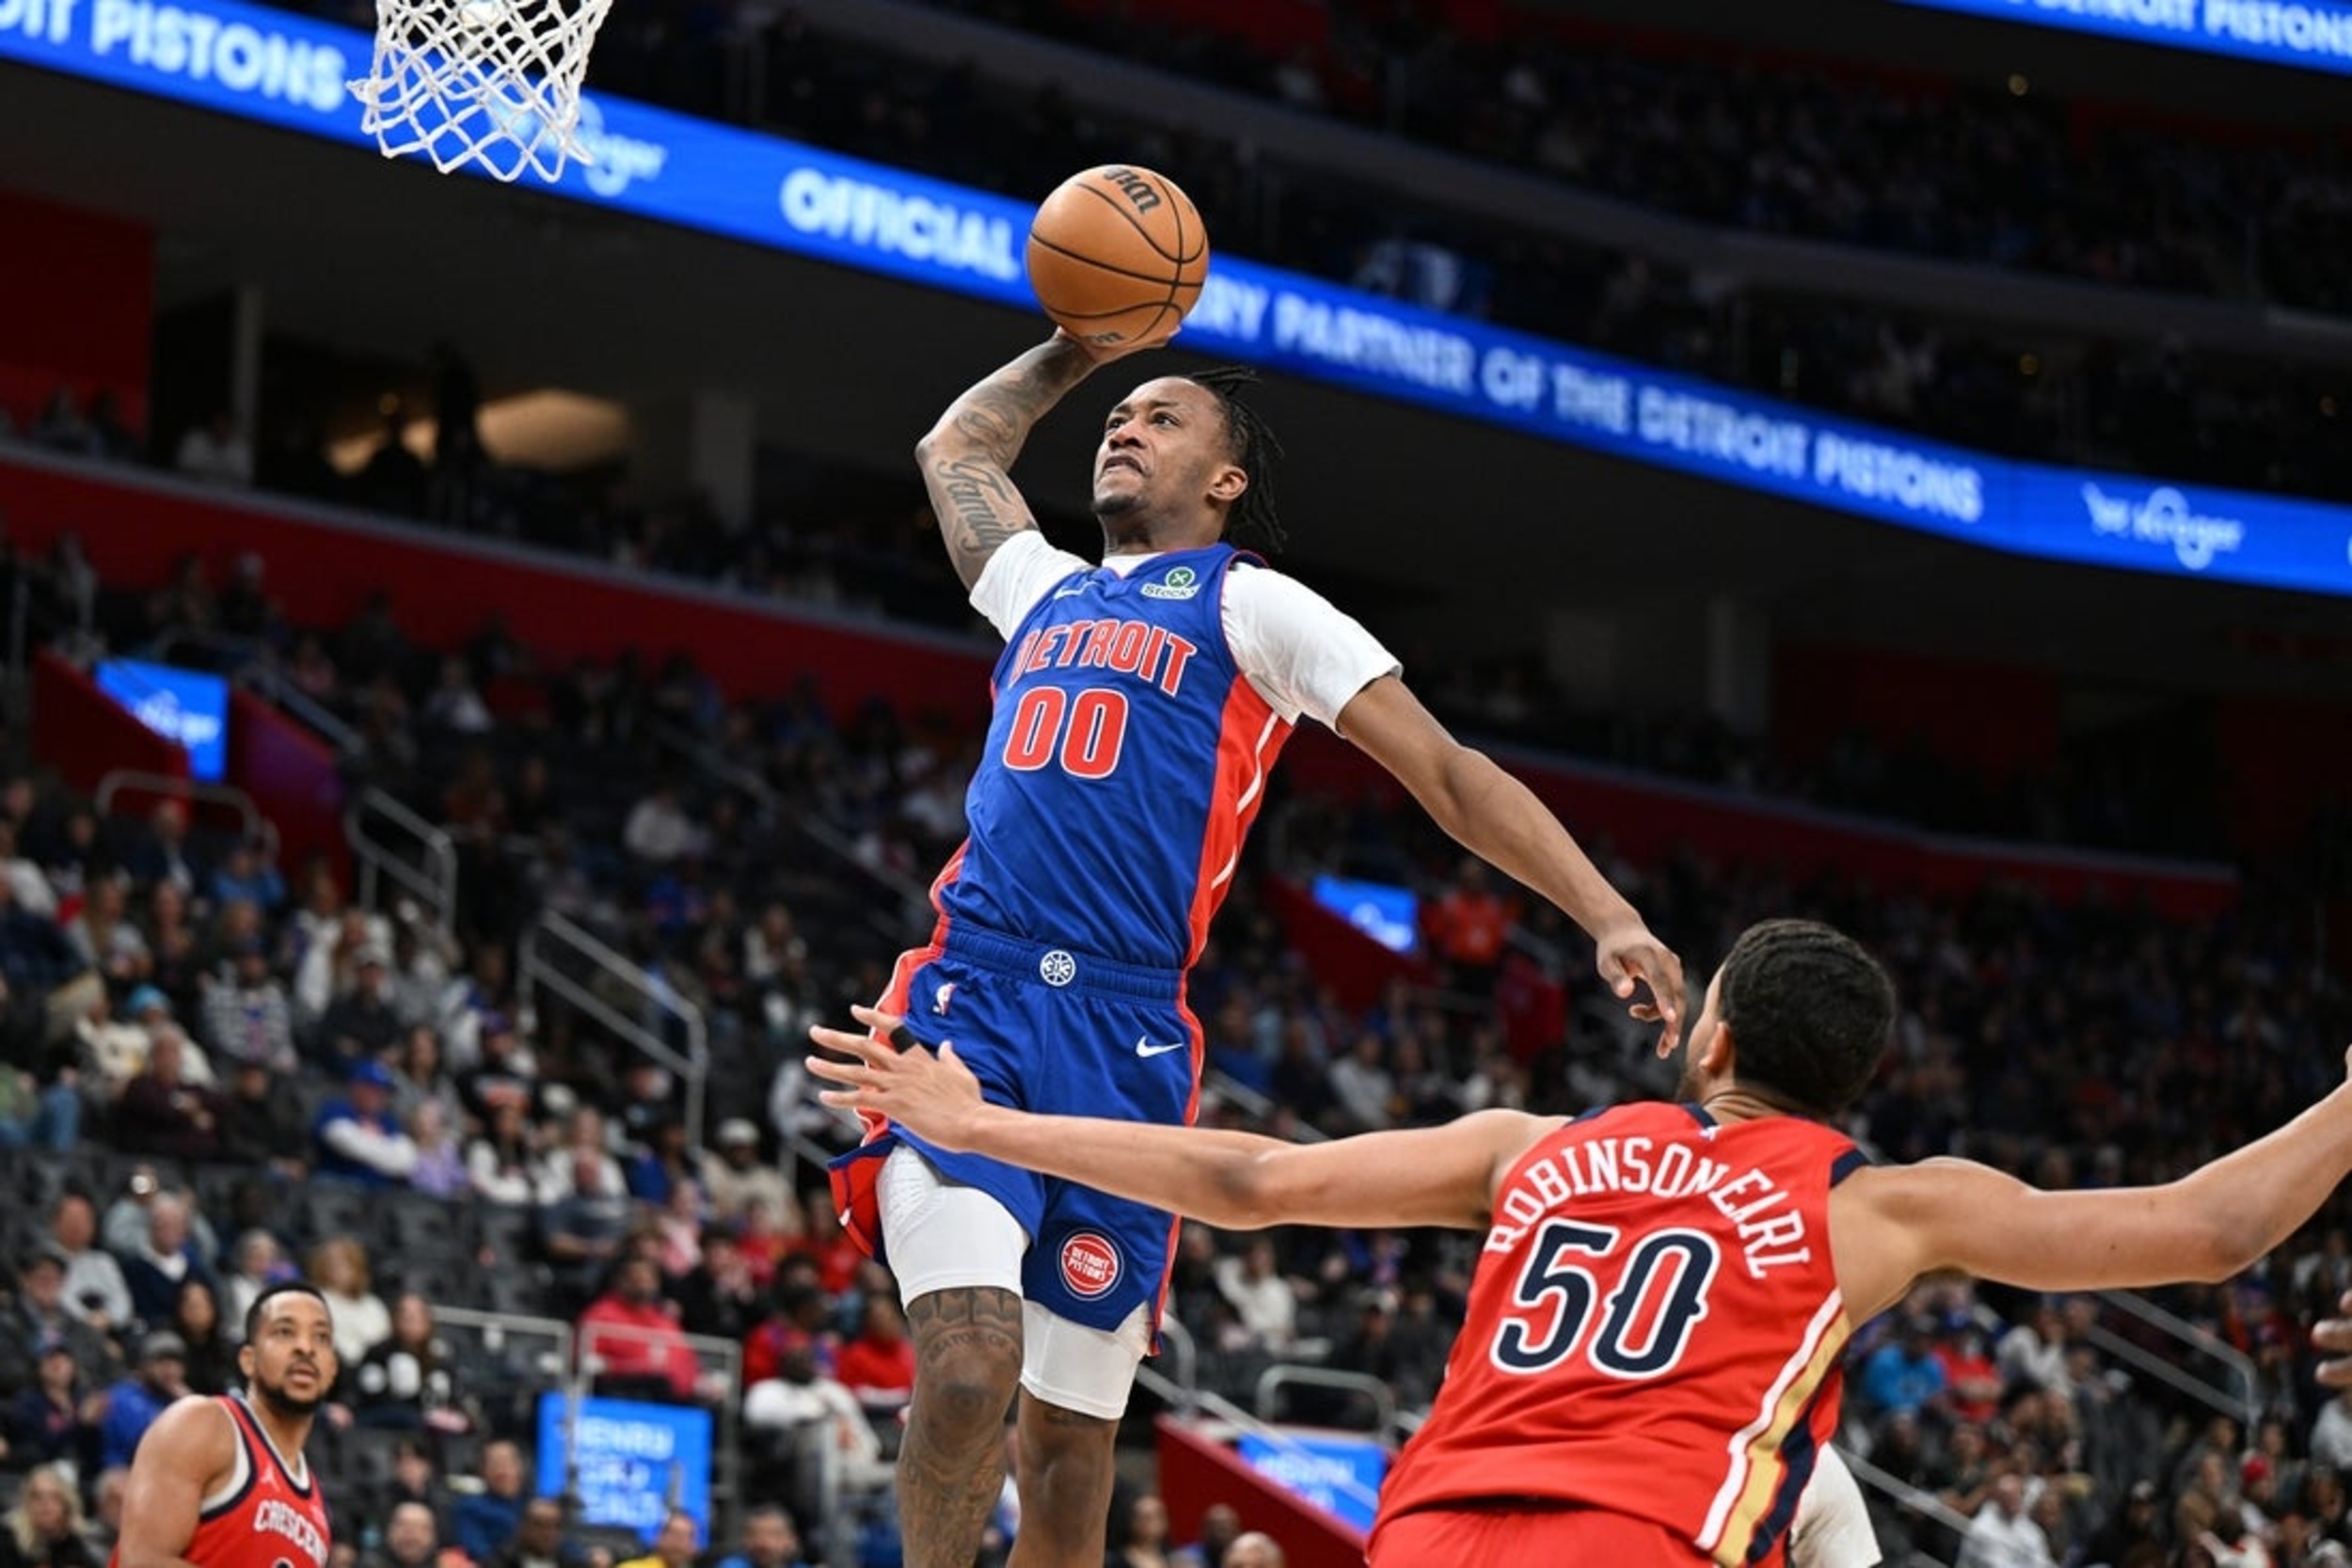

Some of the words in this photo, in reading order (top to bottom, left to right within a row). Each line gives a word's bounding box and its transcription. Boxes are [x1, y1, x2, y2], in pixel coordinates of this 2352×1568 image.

[91, 0, 346, 112] PISTONS
[780, 167, 1021, 280] OFFICIAL
[1273, 291, 1476, 396] PARTNER
[1481, 347, 1543, 411] OF
[1553, 363, 1630, 434] THE
[1637, 385, 1811, 479] DETROIT
[1815, 431, 1983, 524] PISTONS
[1009, 618, 1196, 697] DETROIT
[1004, 687, 1128, 779] 00
[1490, 1216, 1721, 1377] 50
